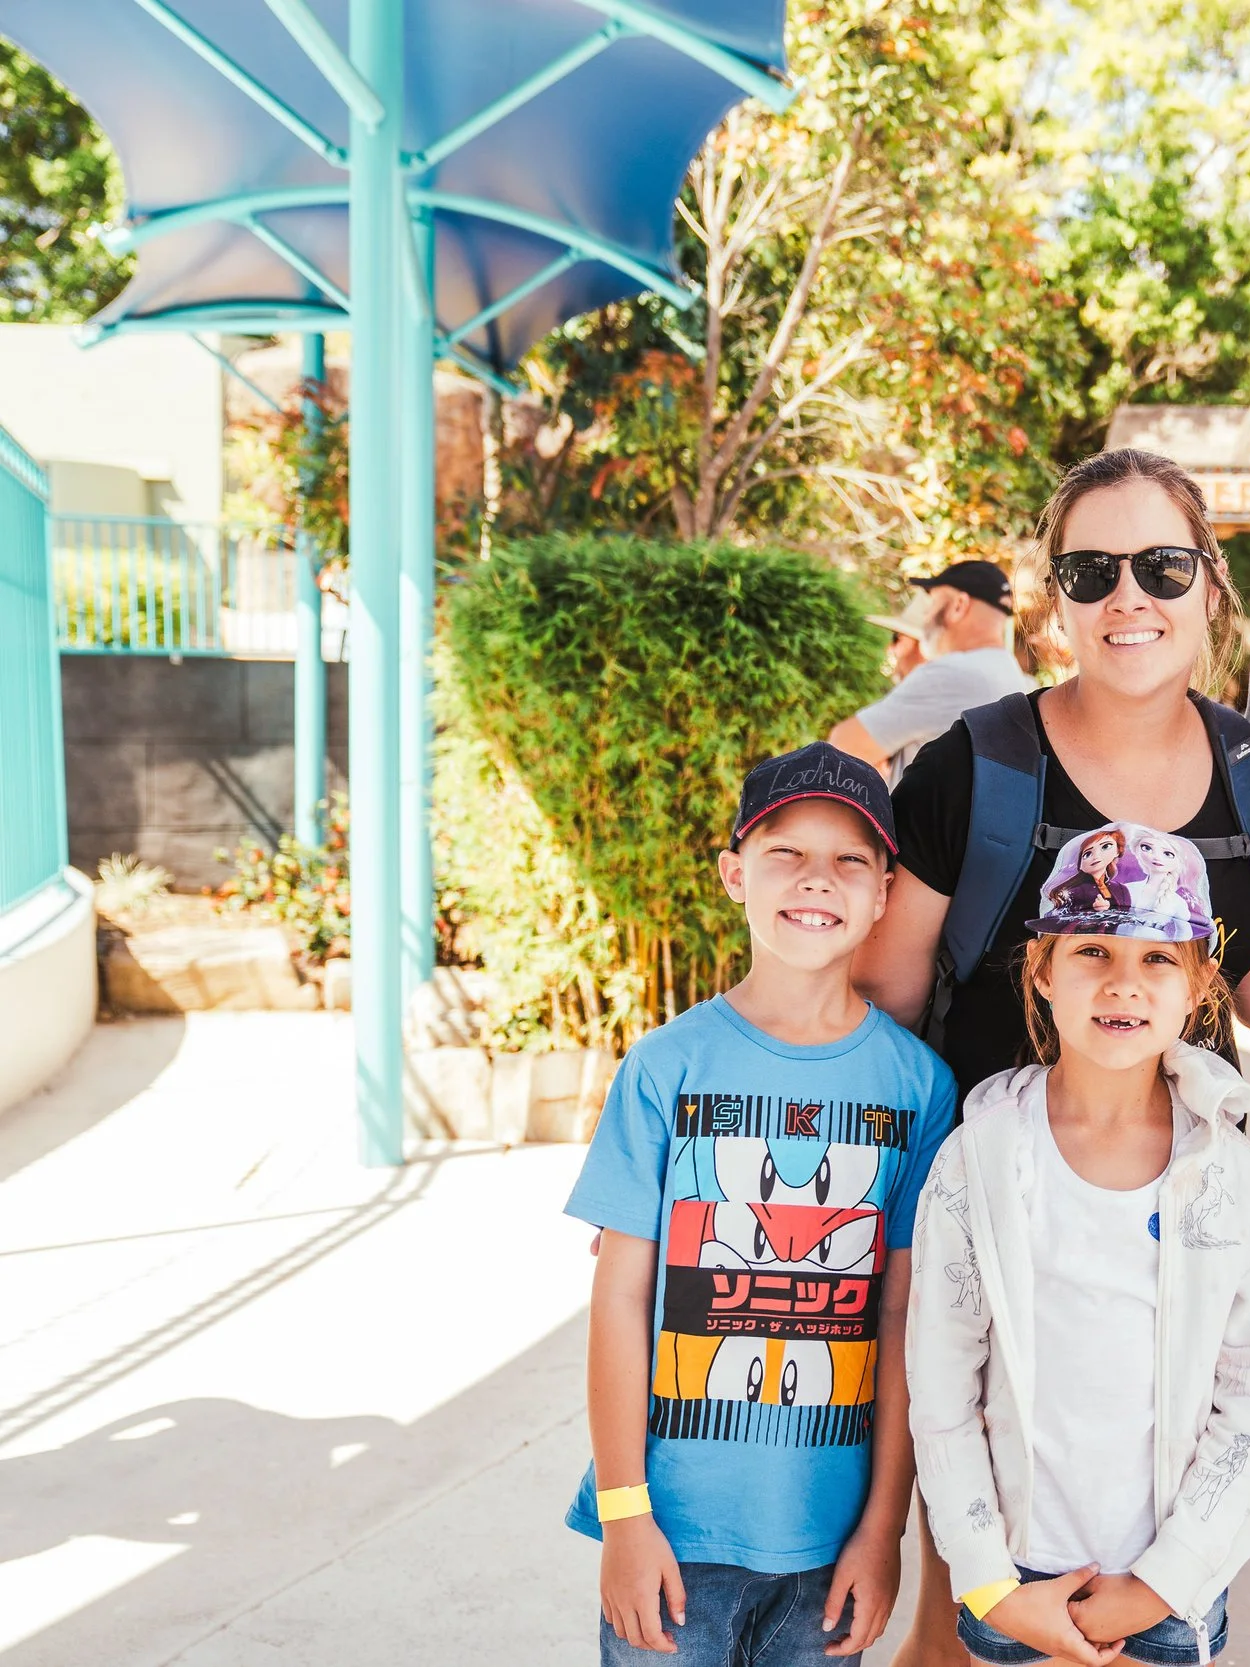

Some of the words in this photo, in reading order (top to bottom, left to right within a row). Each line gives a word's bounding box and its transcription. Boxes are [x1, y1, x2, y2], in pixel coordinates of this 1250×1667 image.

[785, 1102, 825, 1137] K
[863, 1110, 893, 1141] T
[711, 1274, 870, 1315] ソニック
